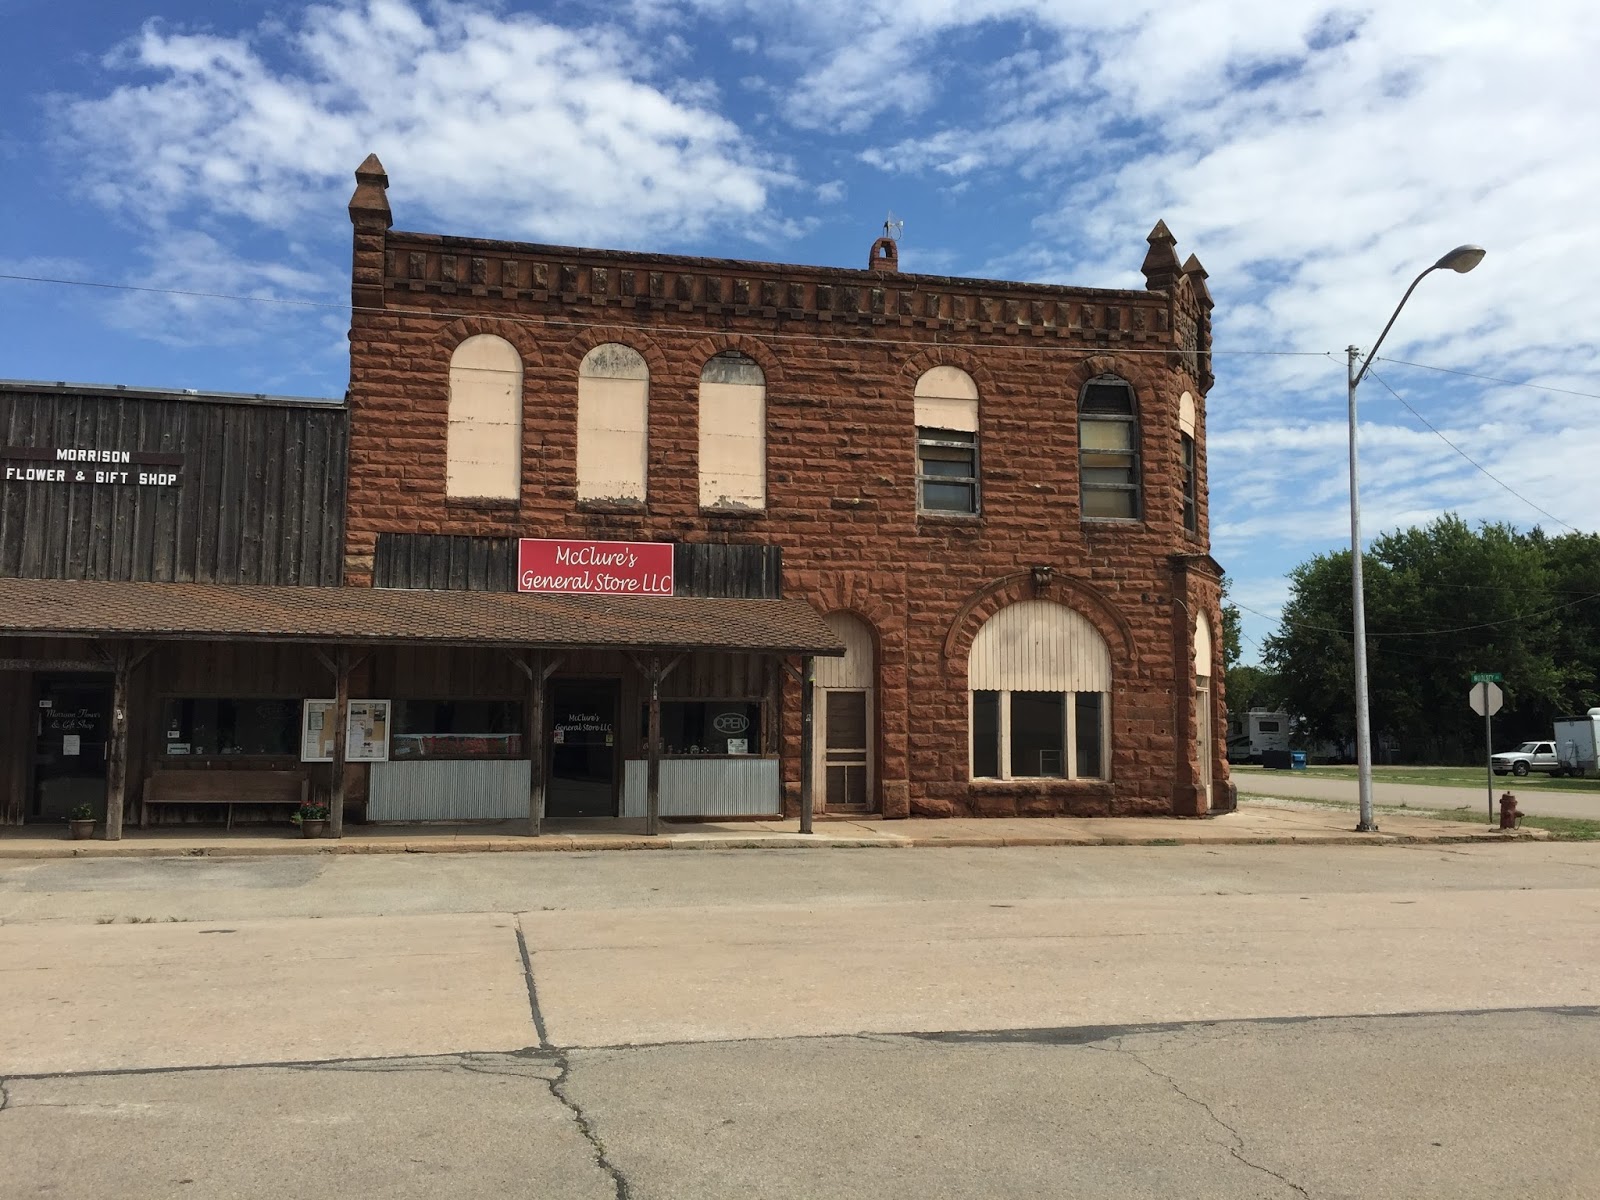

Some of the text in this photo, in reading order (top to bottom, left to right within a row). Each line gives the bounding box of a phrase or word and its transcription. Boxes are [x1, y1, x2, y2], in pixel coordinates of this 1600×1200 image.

[56, 448, 131, 463] MORRISON
[6, 467, 177, 486] FLOWER & GIFT SHOP
[555, 545, 638, 568] McClure's
[521, 569, 671, 593] General Store LLC
[568, 713, 601, 722] McClure's
[715, 717, 746, 729] OPEN
